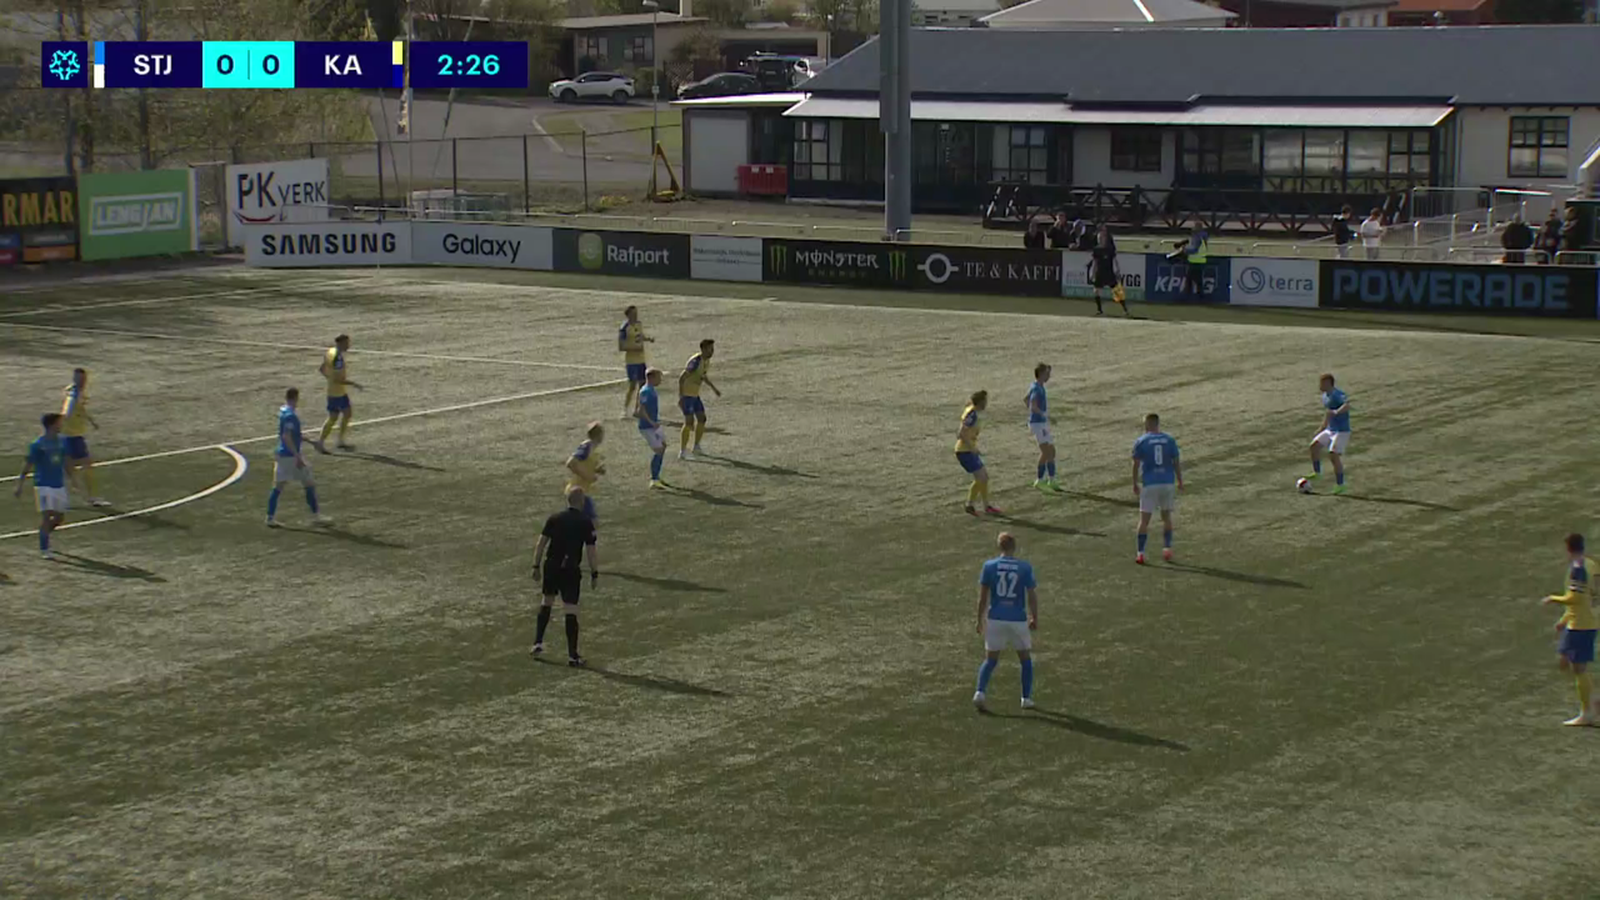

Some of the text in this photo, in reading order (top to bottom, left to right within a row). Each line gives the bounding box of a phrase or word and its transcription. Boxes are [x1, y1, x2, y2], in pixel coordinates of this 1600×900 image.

[261, 231, 397, 255] SAMSUNG
[442, 234, 521, 264] Galaxy
[608, 244, 669, 267] Rafport
[796, 249, 878, 269] MONSTER
[964, 261, 985, 278] TE
[989, 262, 1002, 279] &
[1007, 262, 1060, 282] KAFFI
[1269, 274, 1313, 291] terra
[1334, 269, 1570, 309] POWERADE
[996, 571, 1018, 598] 32
